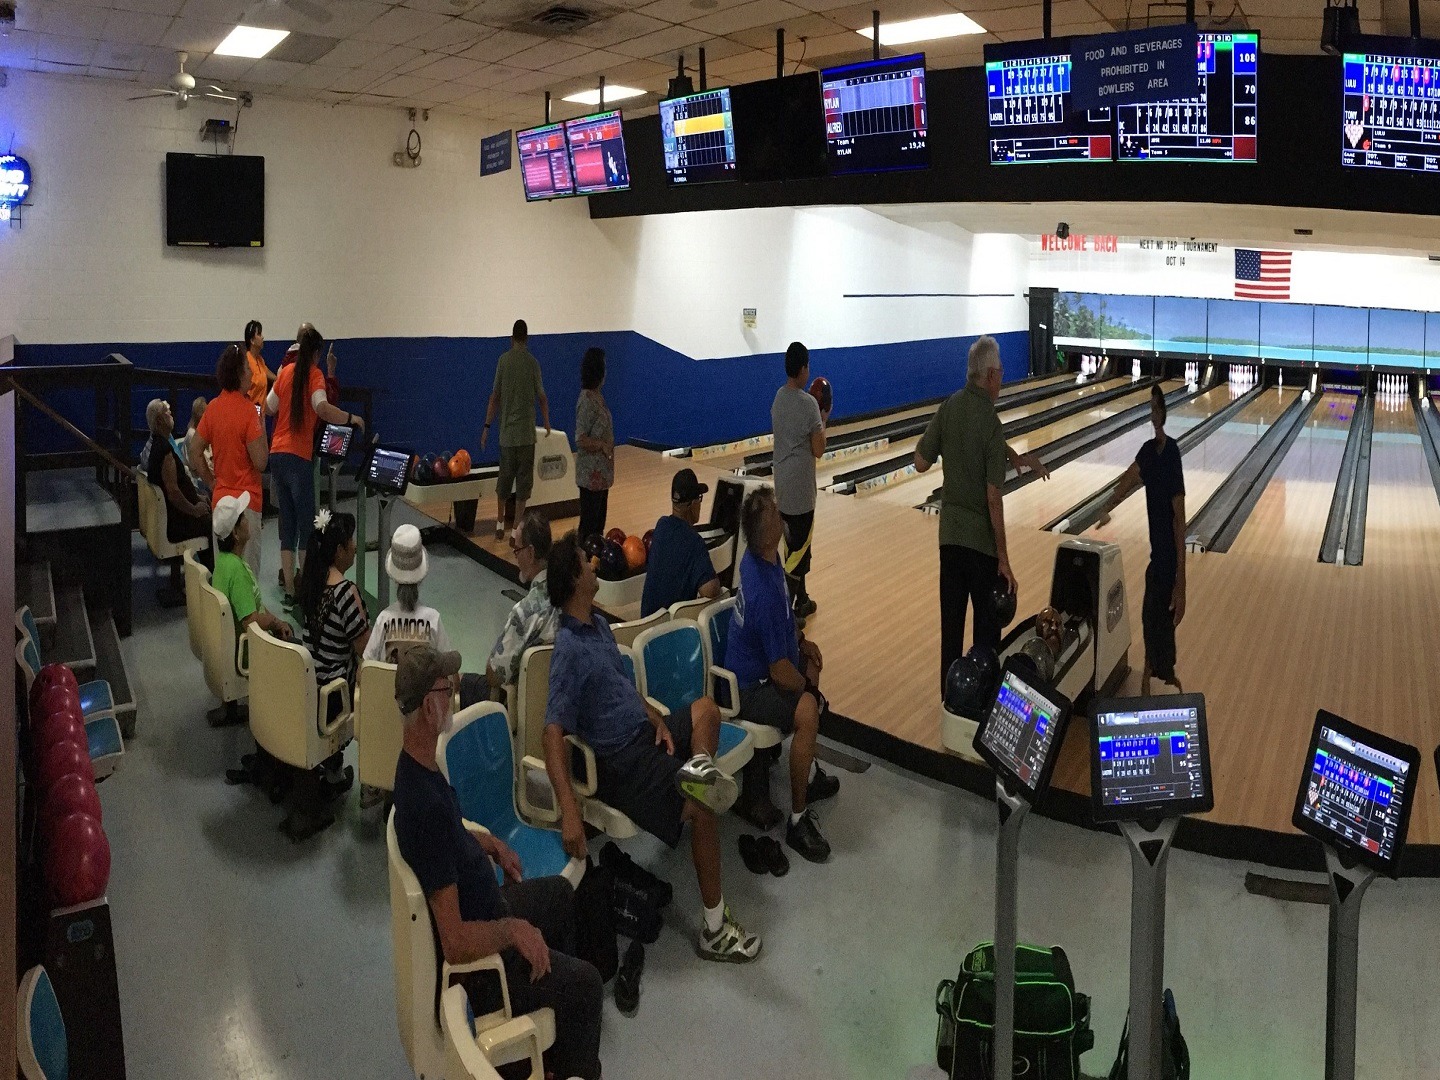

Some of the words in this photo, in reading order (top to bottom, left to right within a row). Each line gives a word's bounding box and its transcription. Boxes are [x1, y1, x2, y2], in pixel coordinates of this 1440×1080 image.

[1085, 49, 1105, 62] FOOD
[1110, 46, 1128, 56] AND
[1134, 38, 1183, 54] BEVERAGES
[1239, 53, 1256, 63] 108
[1101, 62, 1149, 78] PROHIBITED
[1156, 60, 1165, 70] IN
[1098, 82, 1134, 97] BOWLERS
[1148, 78, 1168, 90] AREA
[1244, 85, 1256, 94] 70
[1244, 116, 1256, 126] 86
[1042, 234, 1086, 251] WELCOME
[1094, 234, 1118, 253] BACK
[1140, 239, 1154, 250] NEXT
[1156, 241, 1164, 250] NO
[1167, 241, 1178, 250] TAP
[1183, 241, 1218, 253] TOURNAMENT
[1166, 256, 1176, 266] OCT
[1180, 256, 1186, 266] 14
